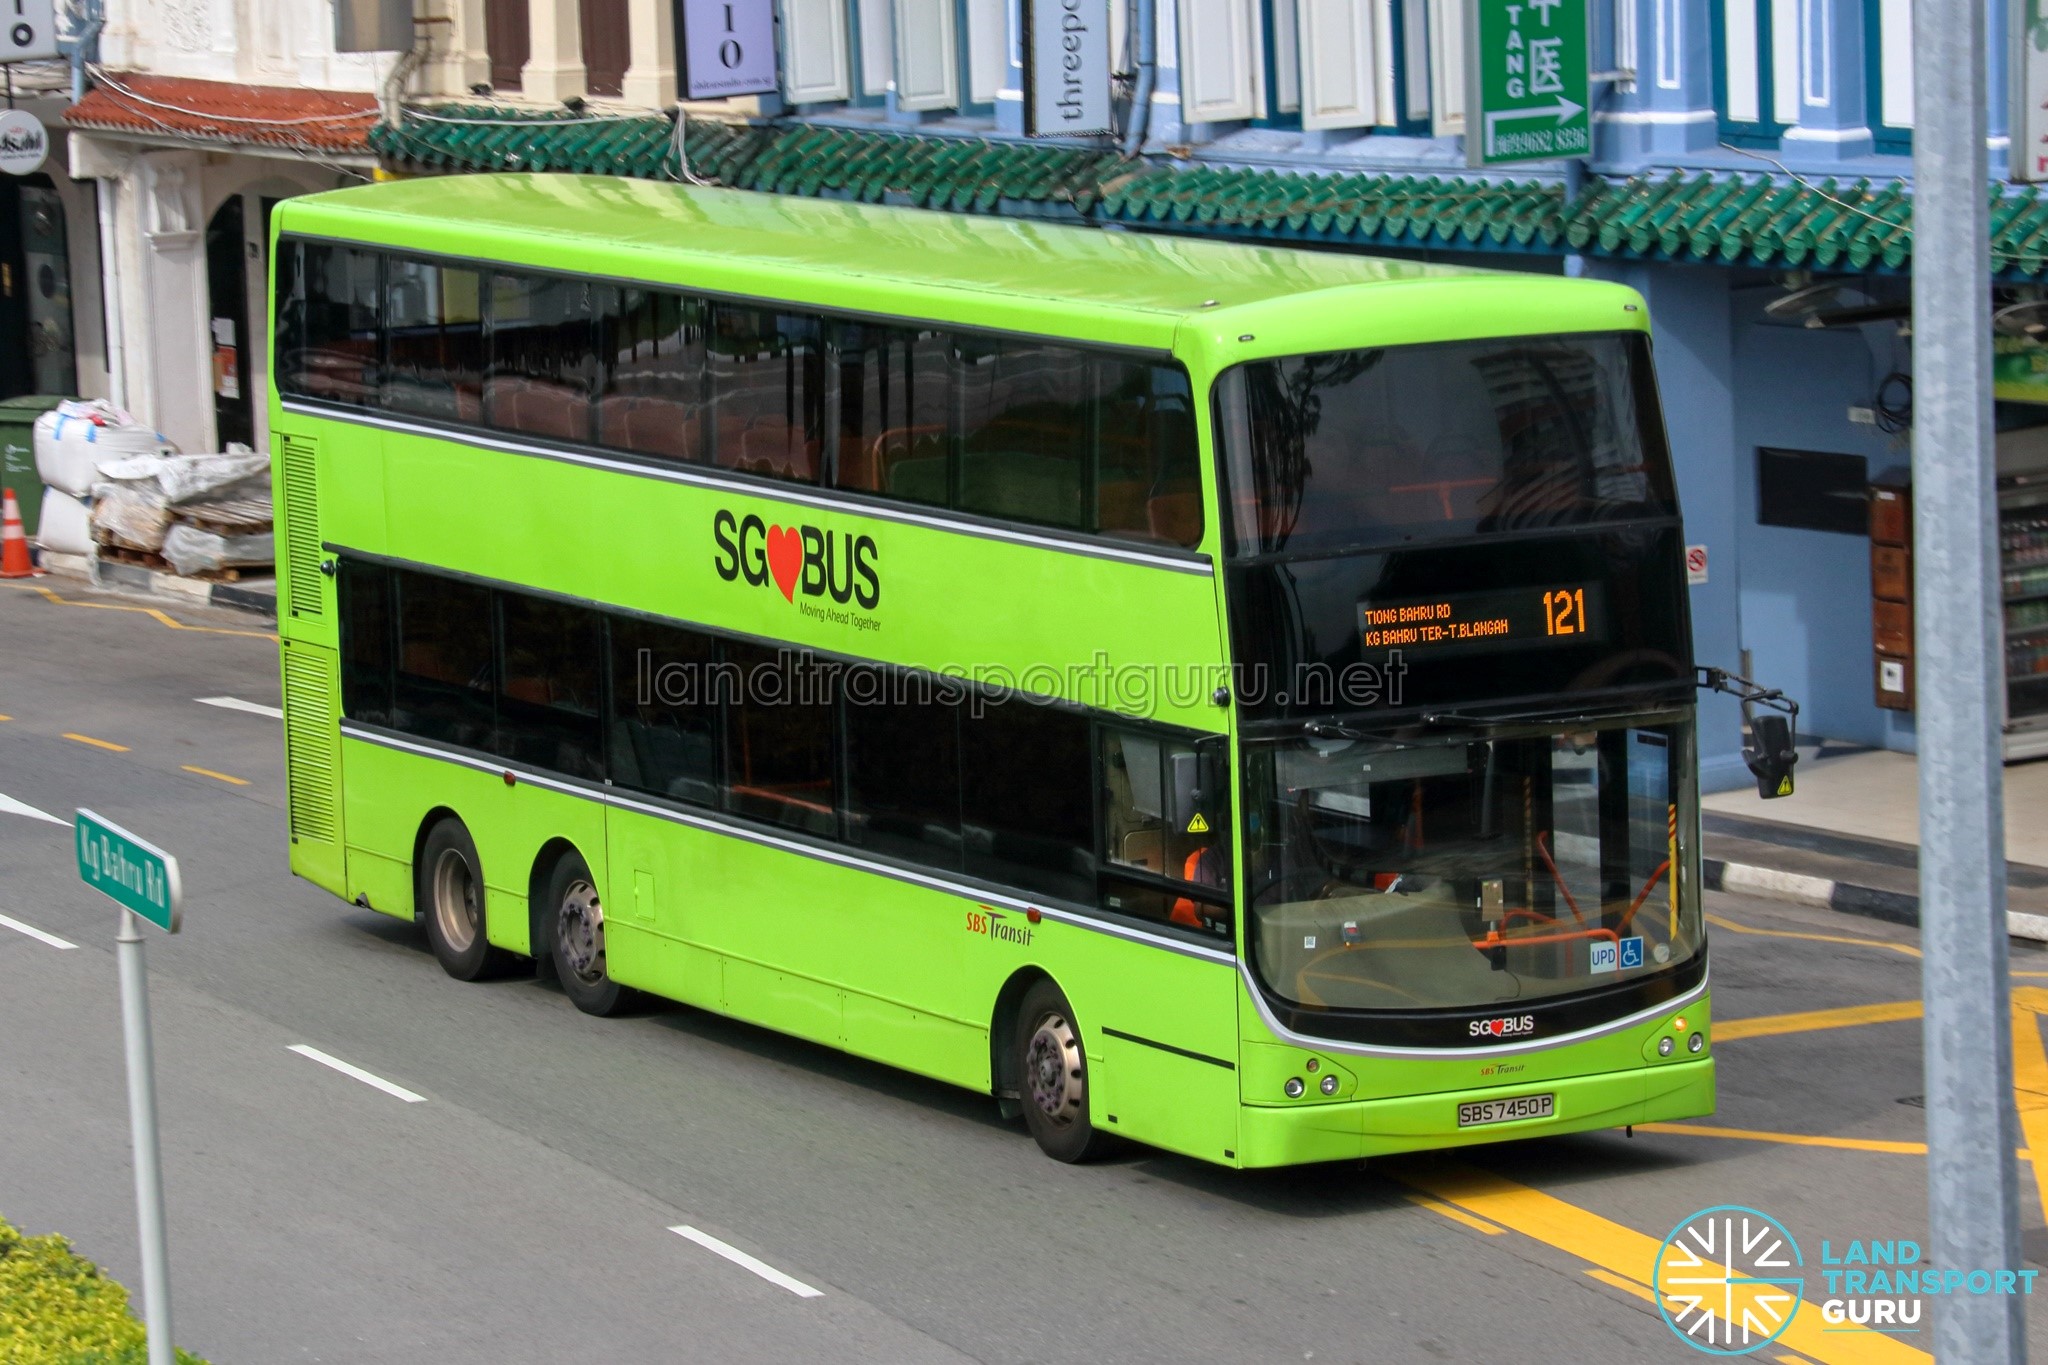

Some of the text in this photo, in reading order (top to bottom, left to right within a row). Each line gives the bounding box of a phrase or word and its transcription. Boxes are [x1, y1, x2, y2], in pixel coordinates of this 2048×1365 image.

[1505, 5, 1525, 98] TANG
[800, 602, 881, 632] Moving Ahead Together
[1365, 603, 1450, 625] TIONG BAHRU RD
[1543, 588, 1585, 636] 121
[1365, 630, 1381, 647] KG
[1382, 627, 1418, 645] BAHRU
[80, 823, 165, 909] Kg Bahru Rd
[966, 910, 1035, 947] SBS Transit
[1591, 948, 1616, 966] UPD
[1480, 1063, 1525, 1076] SBS Transit
